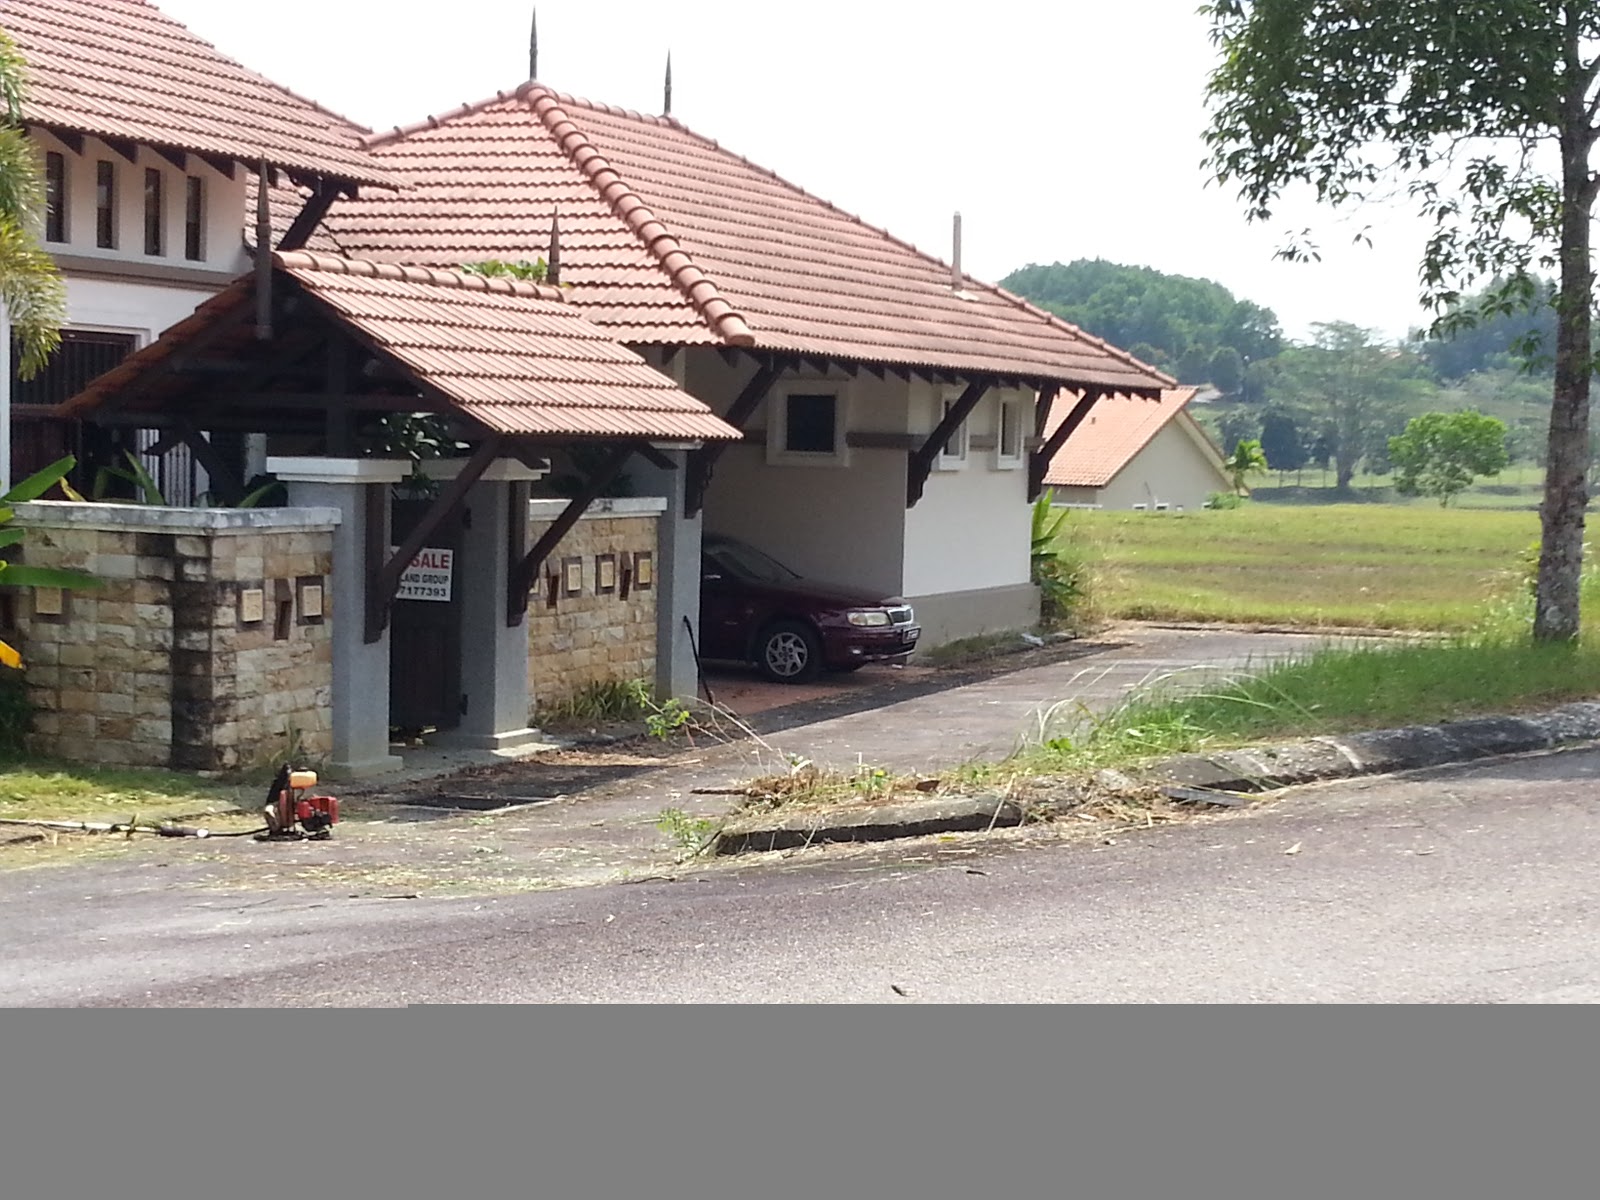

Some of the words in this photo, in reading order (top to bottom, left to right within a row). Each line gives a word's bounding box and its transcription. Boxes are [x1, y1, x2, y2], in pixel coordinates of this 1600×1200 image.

[409, 553, 449, 569] SALE
[422, 574, 449, 585] GROUP
[400, 586, 447, 597] 7177393
